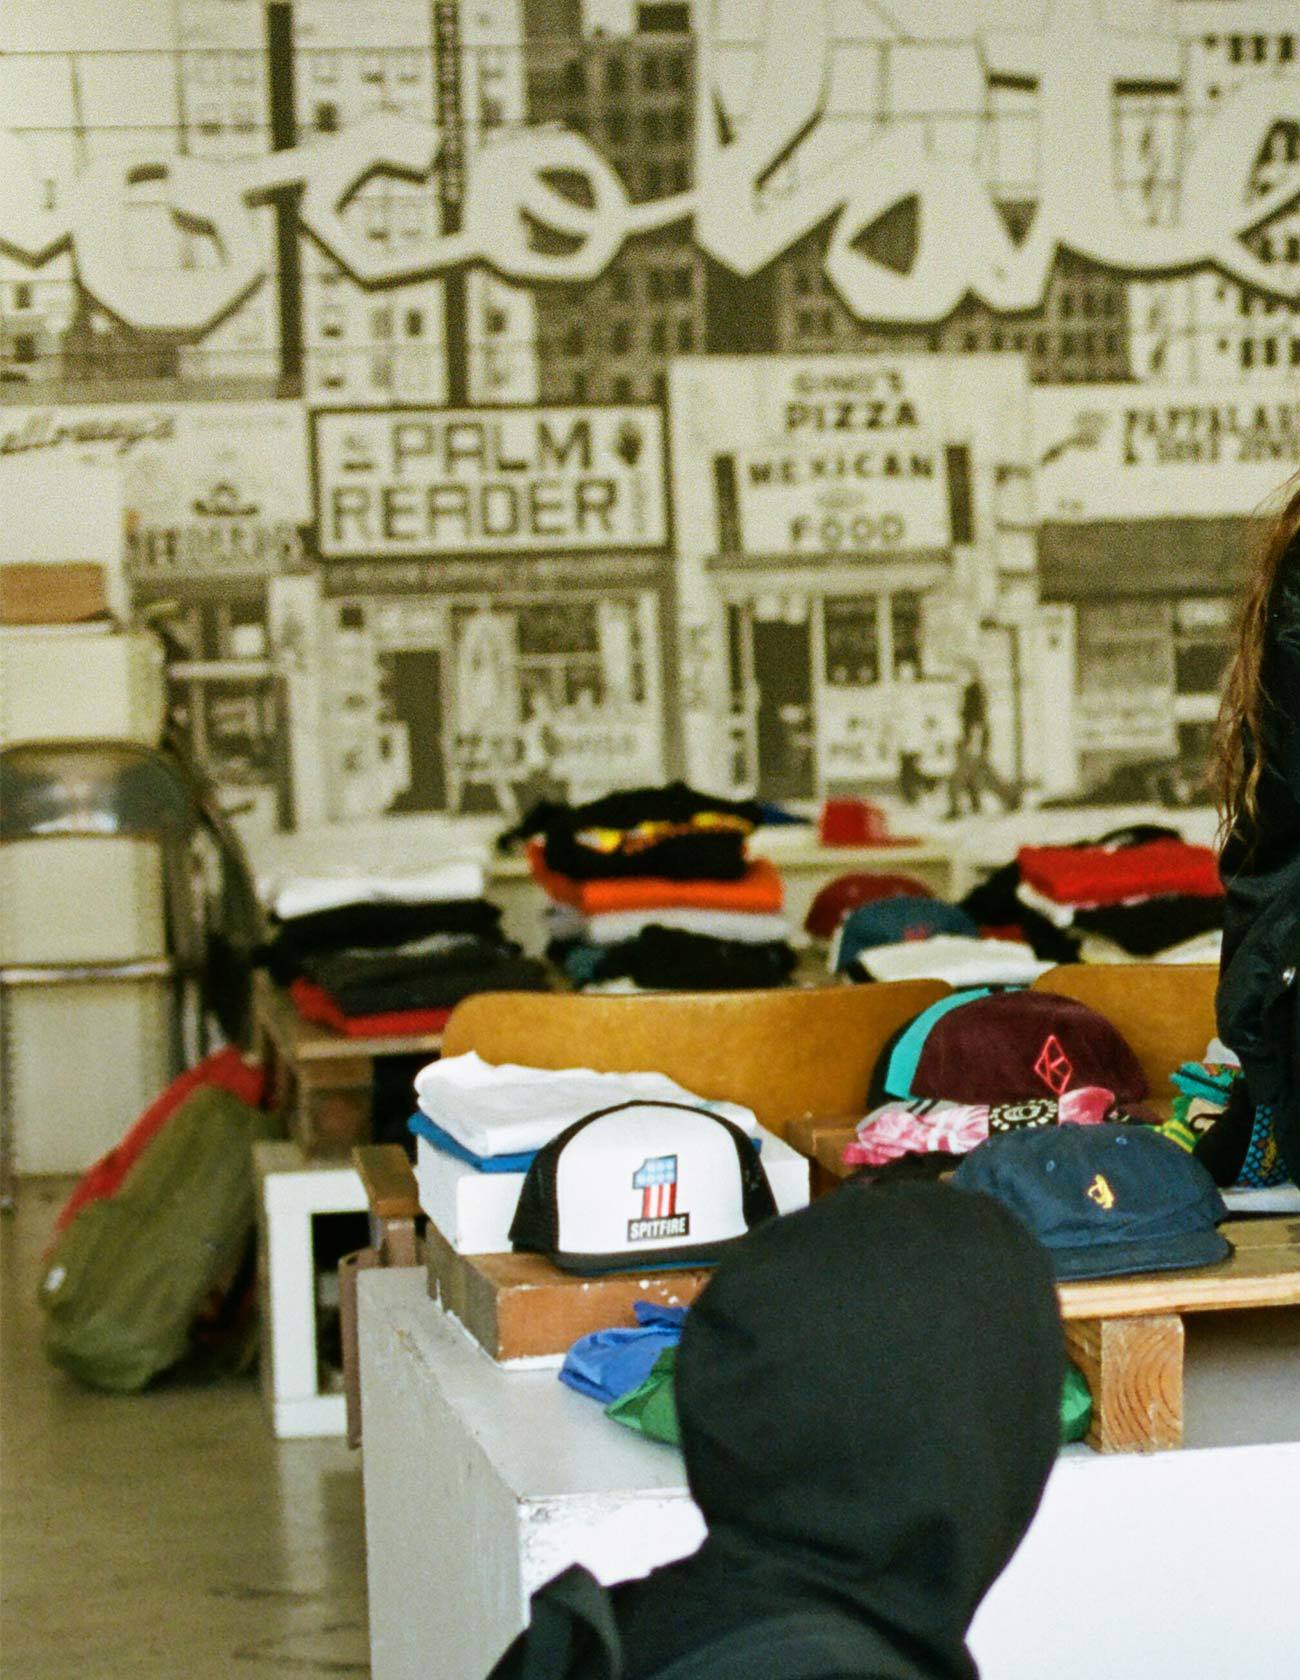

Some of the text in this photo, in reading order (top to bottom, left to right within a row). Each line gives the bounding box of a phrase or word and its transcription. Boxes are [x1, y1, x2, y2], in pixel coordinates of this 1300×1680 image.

[785, 400, 918, 432] PIZZA
[393, 419, 591, 477] PALM
[748, 452, 934, 487] MEXICAN
[331, 476, 620, 541] READER
[789, 513, 904, 548] FOOD
[630, 1216, 686, 1240] SPITFIRE
